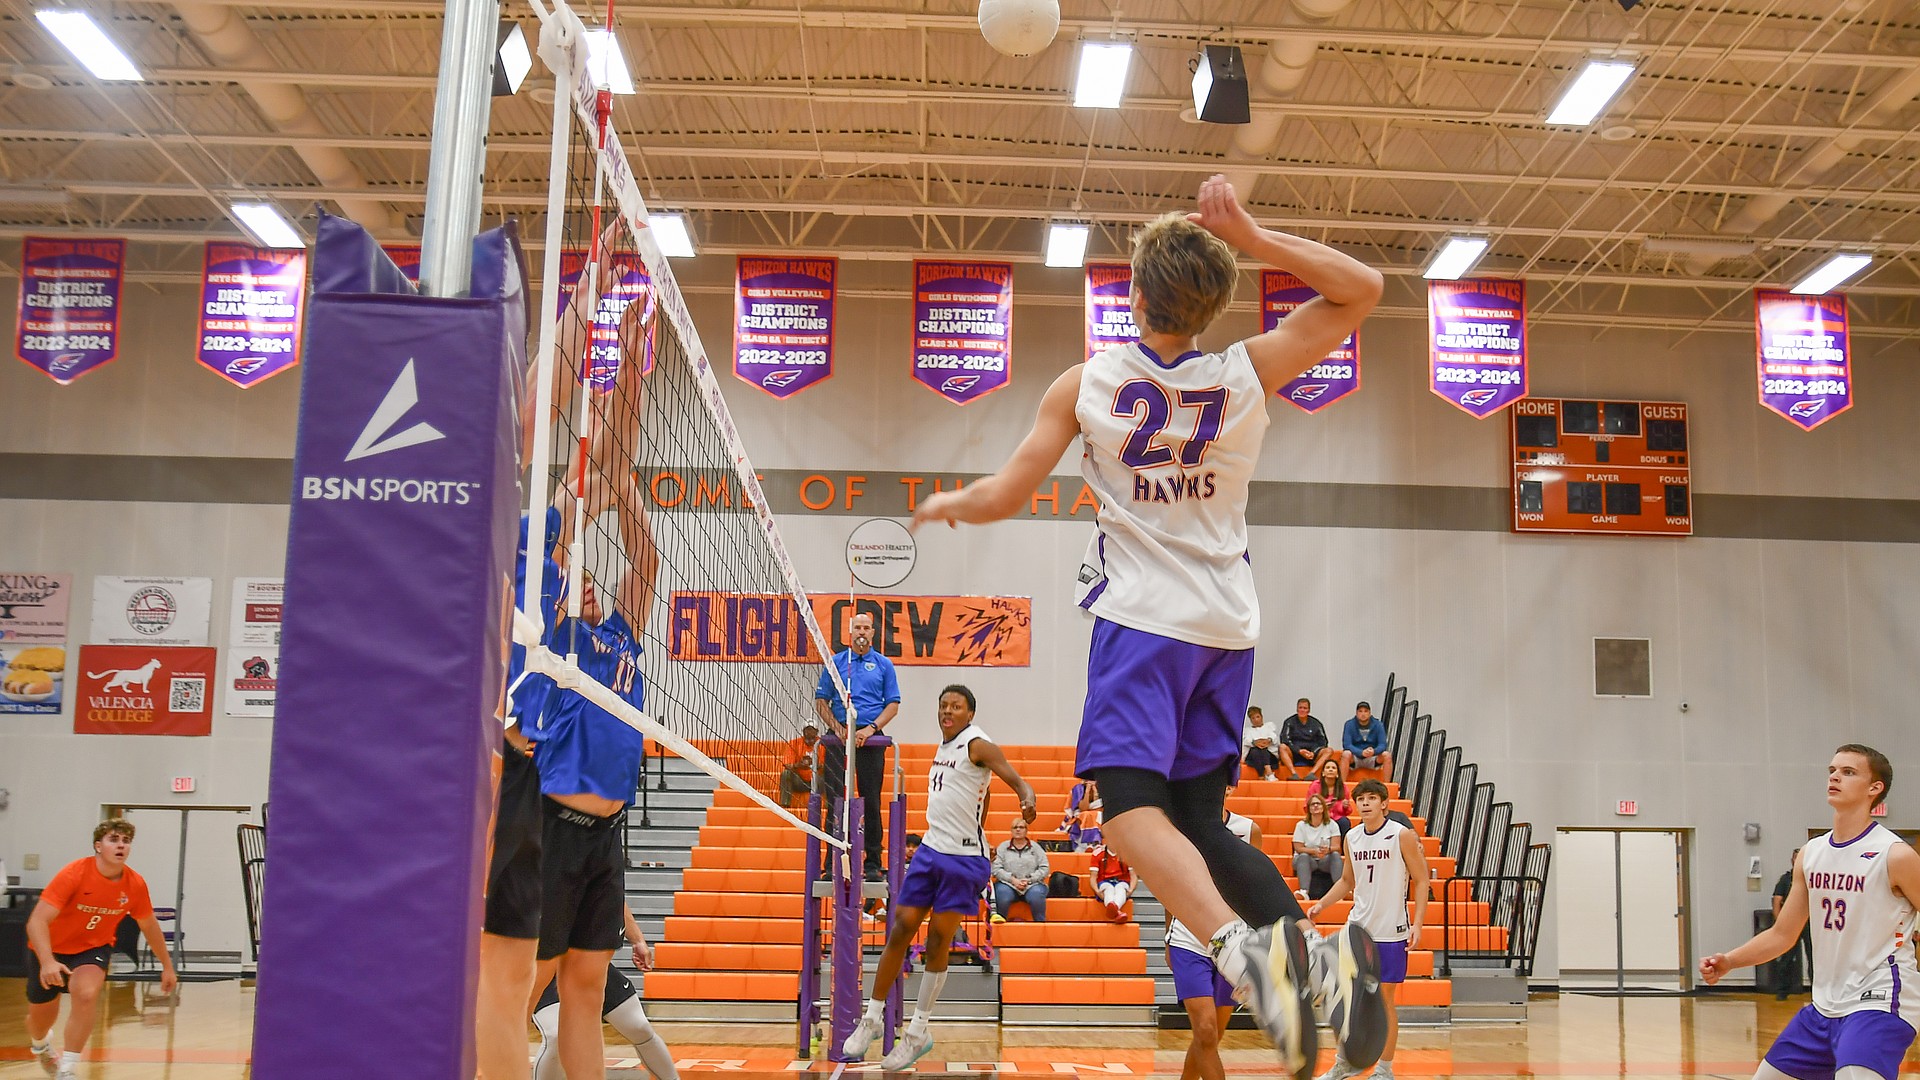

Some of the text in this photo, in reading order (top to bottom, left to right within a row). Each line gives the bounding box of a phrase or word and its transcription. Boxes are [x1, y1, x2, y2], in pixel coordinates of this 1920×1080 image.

[742, 260, 832, 283] HORIZON HAWKS
[919, 265, 1009, 288] HORIZON HAWKS
[38, 282, 105, 294] DISTRICT
[1265, 273, 1309, 295] HORIZO
[26, 294, 113, 308] CHAMPIONS
[217, 289, 286, 304] DISTRICT
[747, 289, 824, 298] GIRLS VOLLEYBALL
[206, 302, 295, 318] CHAMPIONS
[751, 303, 819, 317] DISTRICT
[1273, 302, 1294, 311] BOYS
[1464, 308, 1515, 318] VOLLEYBALL
[740, 315, 828, 330] CHAMPIONS
[928, 308, 997, 322] DISTRICT
[1102, 311, 1134, 324] DIST
[918, 320, 1006, 336] CHAMPIONS
[1092, 323, 1141, 337] CHAMP
[1445, 321, 1511, 337] DISTRICT
[23, 335, 111, 351] 2023-2024
[203, 336, 292, 353] 2023-2024
[741, 334, 768, 343] CLASS
[785, 336, 820, 345] DISTRICT
[919, 339, 946, 348] CLASS
[946, 340, 960, 348] 3A
[963, 341, 998, 350] DISTRICT
[1436, 334, 1520, 351] CHAMPIONS
[1771, 334, 1835, 348] DISTRICT
[738, 349, 827, 365] 2022-2023
[1763, 346, 1844, 362] CHAMPIONS
[917, 354, 1005, 372] 2022-2023
[1298, 364, 1353, 379] -2023
[1436, 367, 1521, 385] 2023-2024
[1764, 380, 1846, 396] 2023-2024
[1517, 402, 1685, 420] HOME GUEST
[1111, 377, 1230, 471] 27
[1640, 455, 1667, 464] BONUS
[1586, 474, 1620, 483] PLAYER
[1659, 475, 1688, 485] FOULS
[302, 477, 366, 501] BSN
[369, 478, 471, 506] SPORTS
[799, 474, 866, 511] OF
[1132, 472, 1217, 505] HAWKS
[1520, 513, 1689, 526] WON GAME WON
[850, 543, 884, 551] ORLANDO
[990, 598, 1031, 628] HAWKS
[136, 624, 165, 634] CLUB
[672, 595, 814, 658] FLIGHT
[88, 695, 155, 710] VALENCIA
[87, 709, 153, 723] COLLEGE
[1353, 849, 1390, 862] HORIZON
[1366, 864, 1375, 884] 7
[1808, 871, 1866, 893] HORIZON
[1821, 897, 1848, 932] 23
[86, 915, 102, 931] 8
